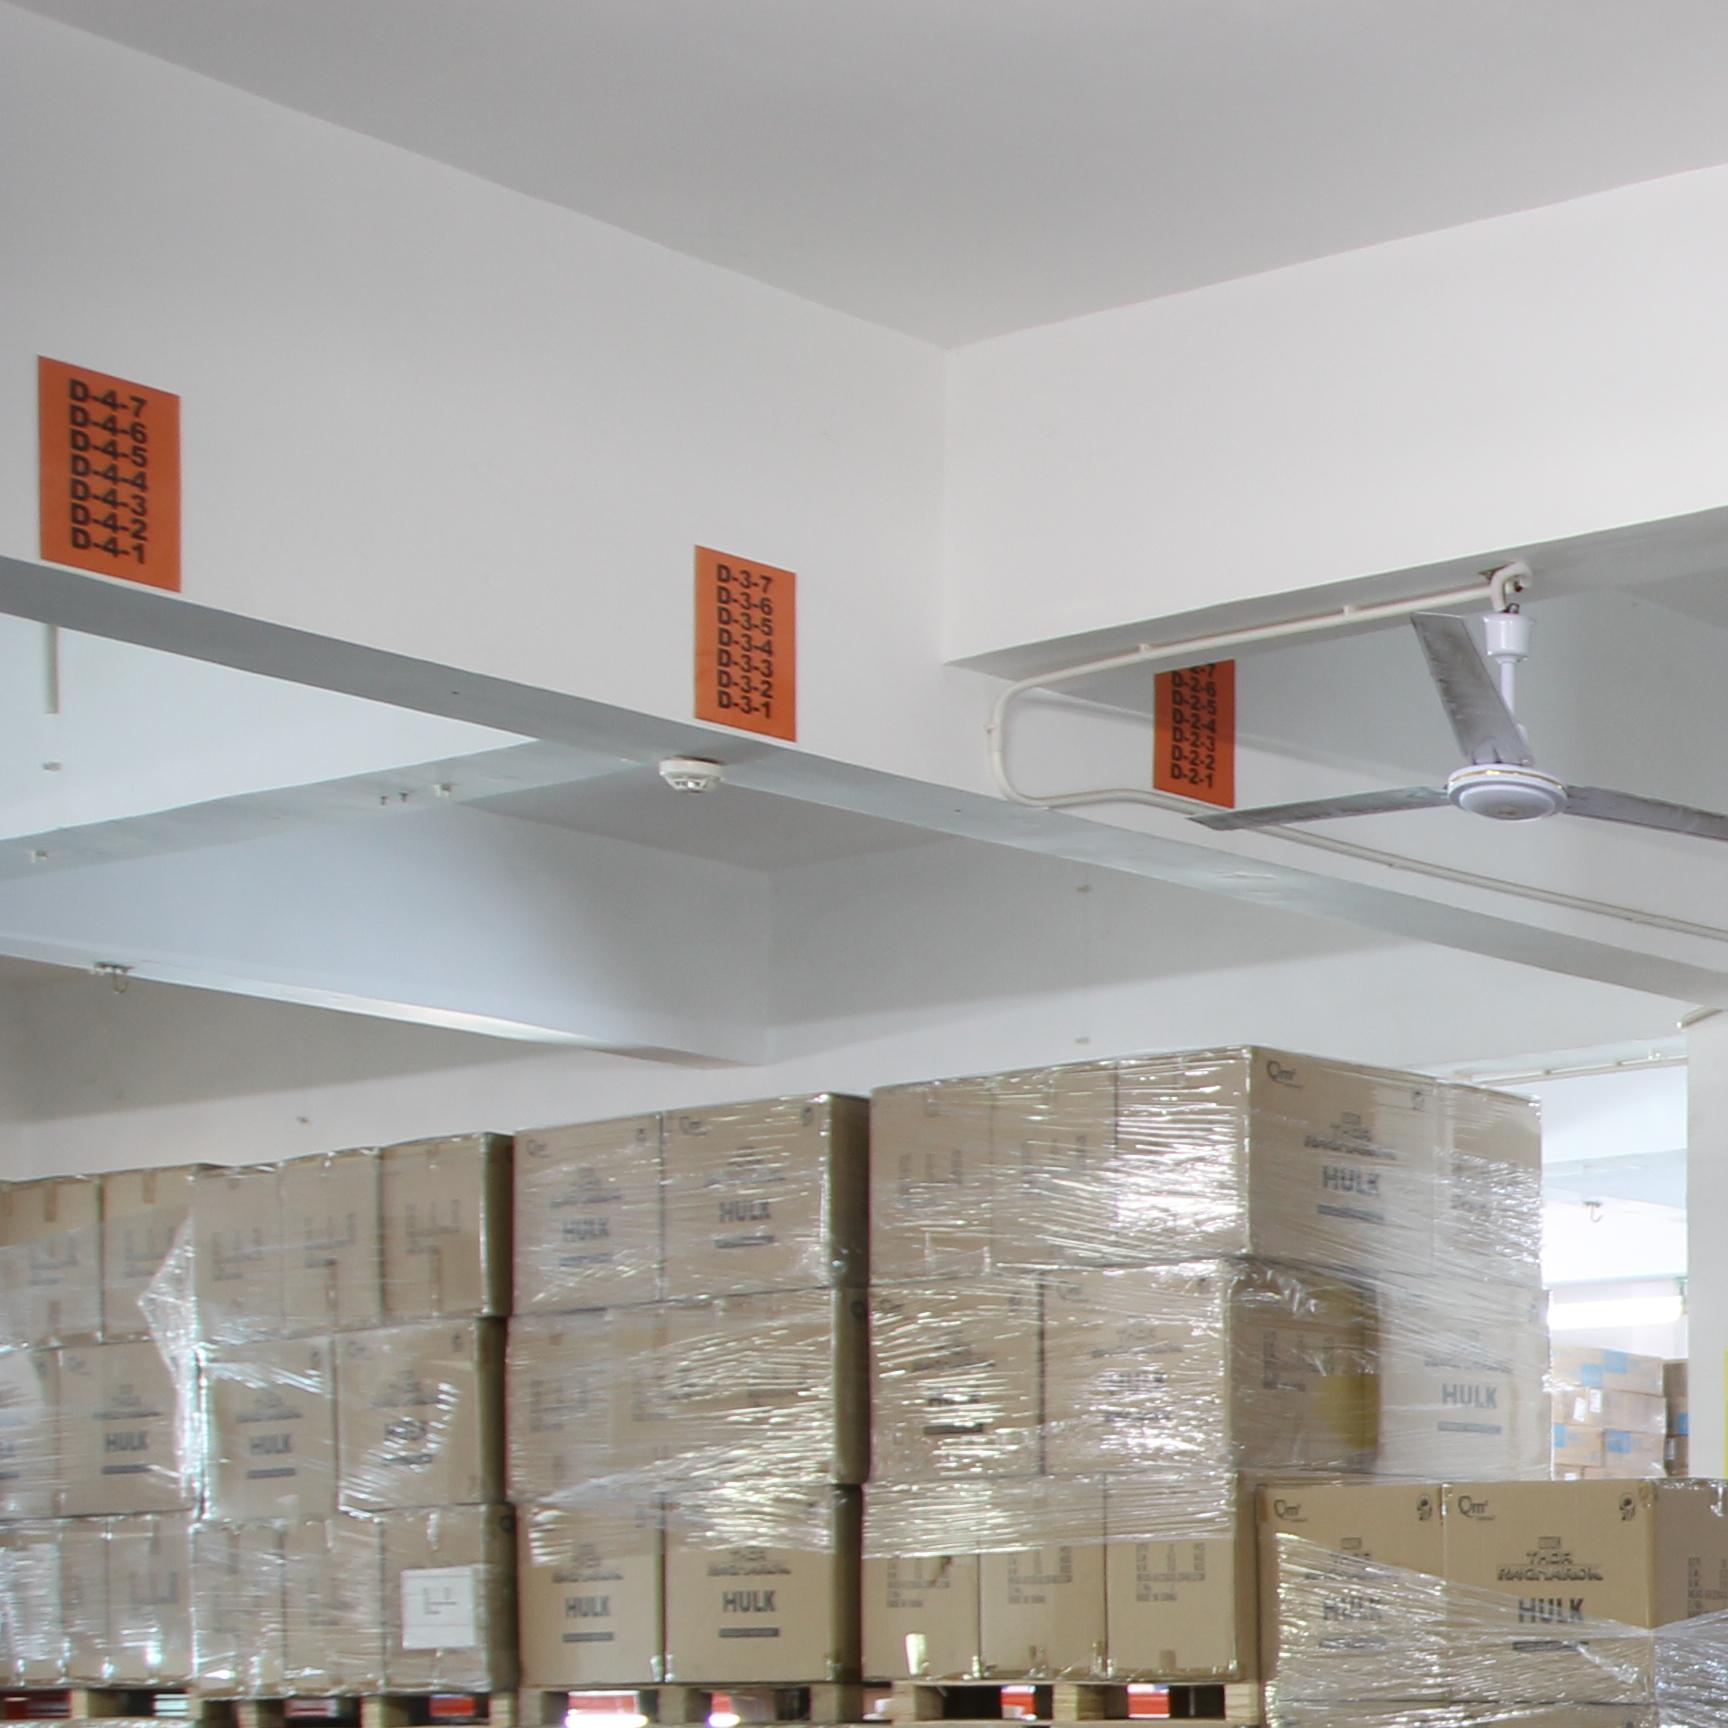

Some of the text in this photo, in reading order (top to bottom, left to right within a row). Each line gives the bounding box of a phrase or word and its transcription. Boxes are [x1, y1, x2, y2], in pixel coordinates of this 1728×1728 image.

[69, 379, 148, 417] D-4-7
[69, 404, 148, 443] D-4-6
[69, 429, 148, 467] D-4-5
[69, 454, 148, 492] D-4-4
[69, 478, 148, 516] D-4-3
[69, 503, 148, 541] D-4-2
[69, 527, 148, 565] D-4-1
[717, 564, 774, 593] D-3-7
[717, 586, 774, 616] D-3-6
[717, 606, 774, 636] D-3-5
[717, 628, 774, 657] D-3-4
[717, 649, 774, 679] D-3-3
[717, 670, 774, 699] D-3-2
[717, 690, 774, 719] D-3-1
[1171, 690, 1217, 716] D-2-5
[1171, 708, 1217, 734] D-2-4
[1171, 727, 1217, 753] D-2-3
[1171, 745, 1217, 771] D-2-2
[1171, 763, 1217, 789] D-2-1
[1322, 1165, 1380, 1196] HULK
[718, 1200, 773, 1223] HULK
[1442, 1383, 1499, 1409] HULK
[565, 1596, 612, 1618] HULK
[723, 1591, 777, 1614] HULK
[1519, 1598, 1584, 1625] HULK
